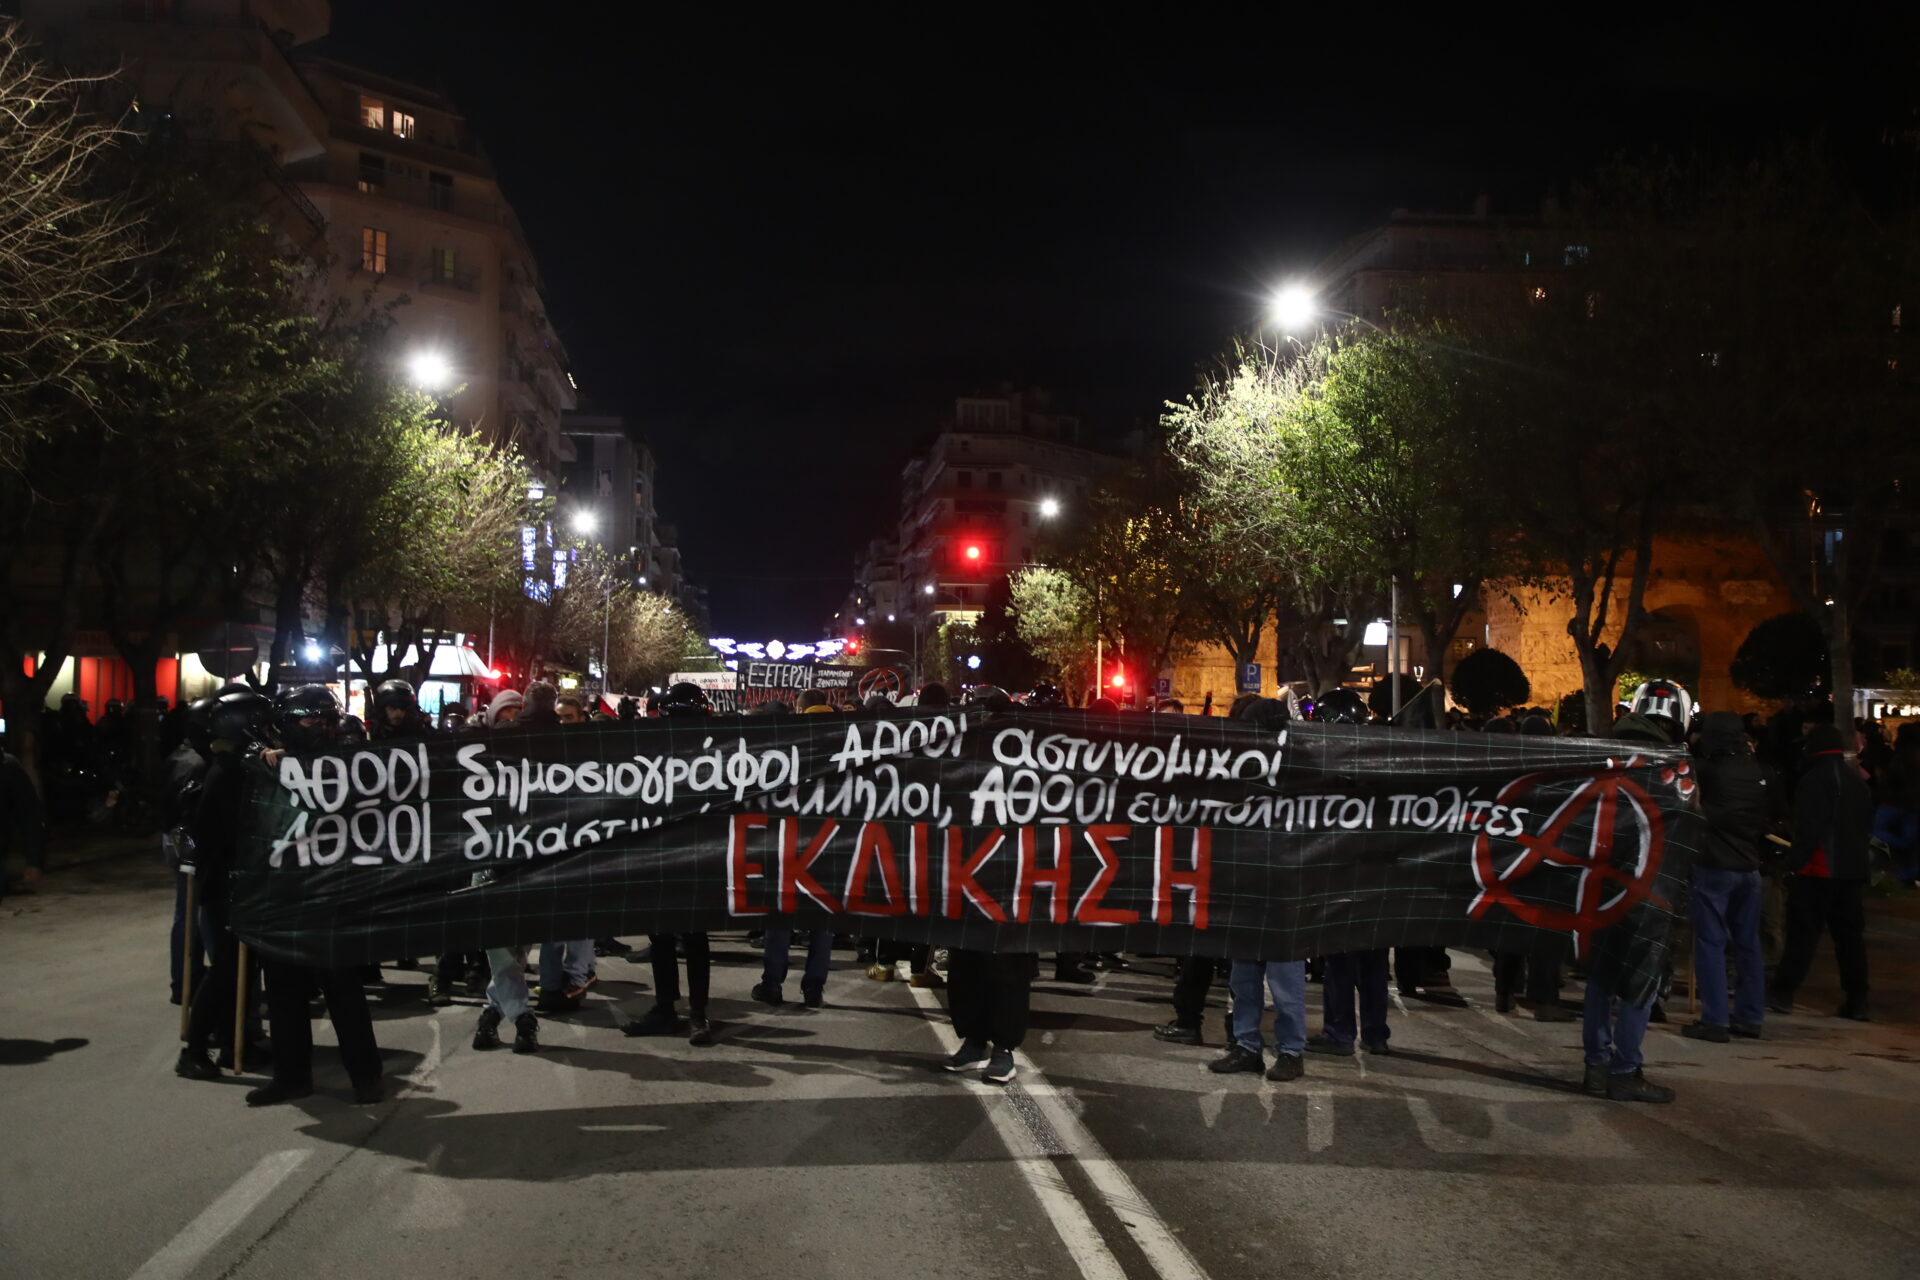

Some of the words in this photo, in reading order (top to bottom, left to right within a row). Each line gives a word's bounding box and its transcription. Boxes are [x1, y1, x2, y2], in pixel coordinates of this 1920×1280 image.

[747, 662, 813, 688] ΕΞΕΓΕΡΣΗ
[1388, 785, 1530, 837] πολίτες
[727, 813, 1212, 930] ΕΚΔΙΚΗΣΗ
